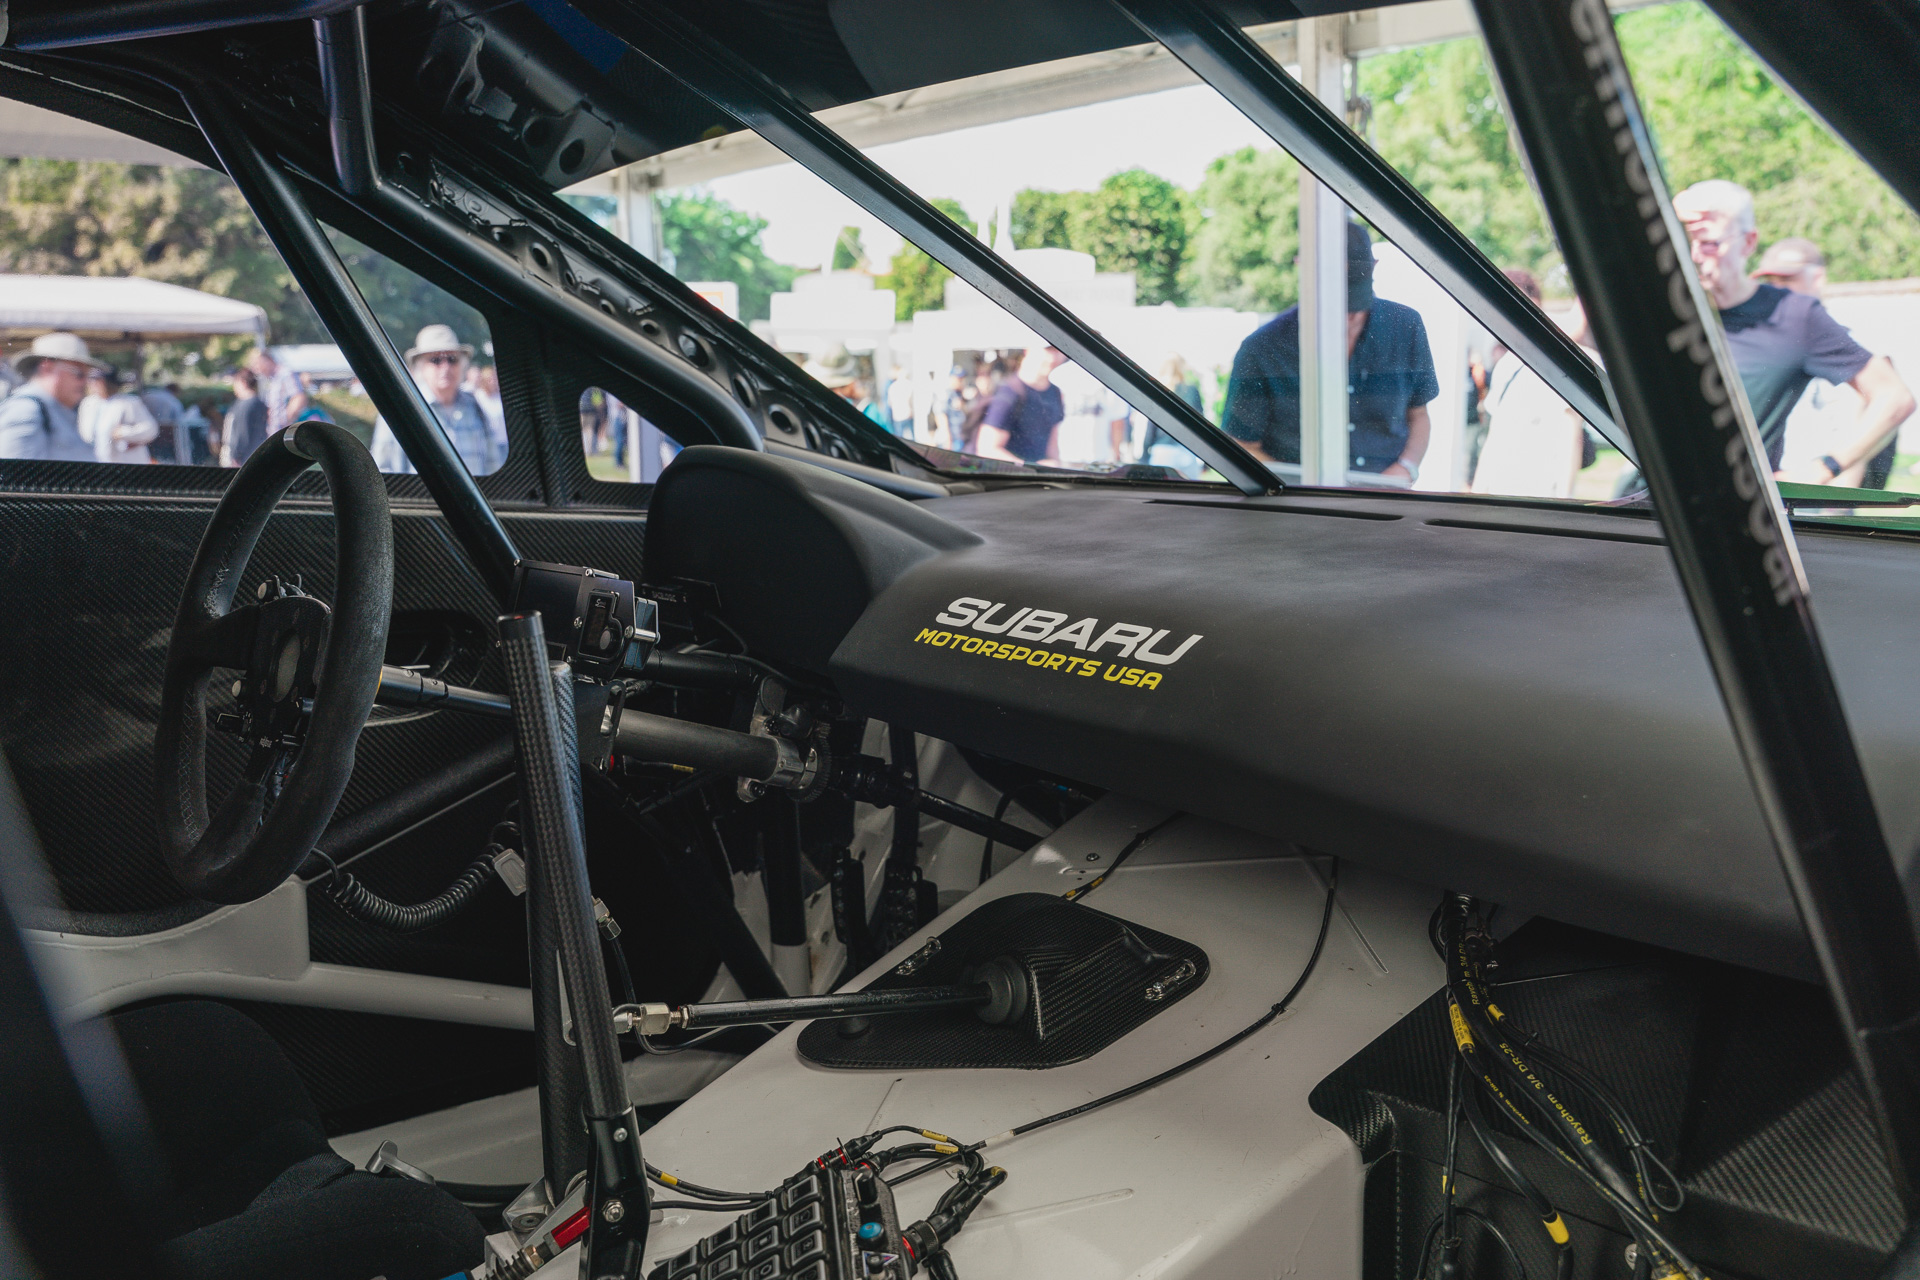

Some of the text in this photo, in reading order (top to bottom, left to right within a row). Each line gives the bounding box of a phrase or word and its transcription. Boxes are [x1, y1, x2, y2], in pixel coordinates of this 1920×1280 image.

[935, 596, 1204, 665] SUBARU
[914, 627, 1163, 690] MOTORSPORTS USA
[1464, 971, 1480, 1005] Raychm
[1499, 1042, 1529, 1072] DR-25
[1526, 1073, 1544, 1090] 3/4
[1547, 1093, 1593, 1145] Raychem
